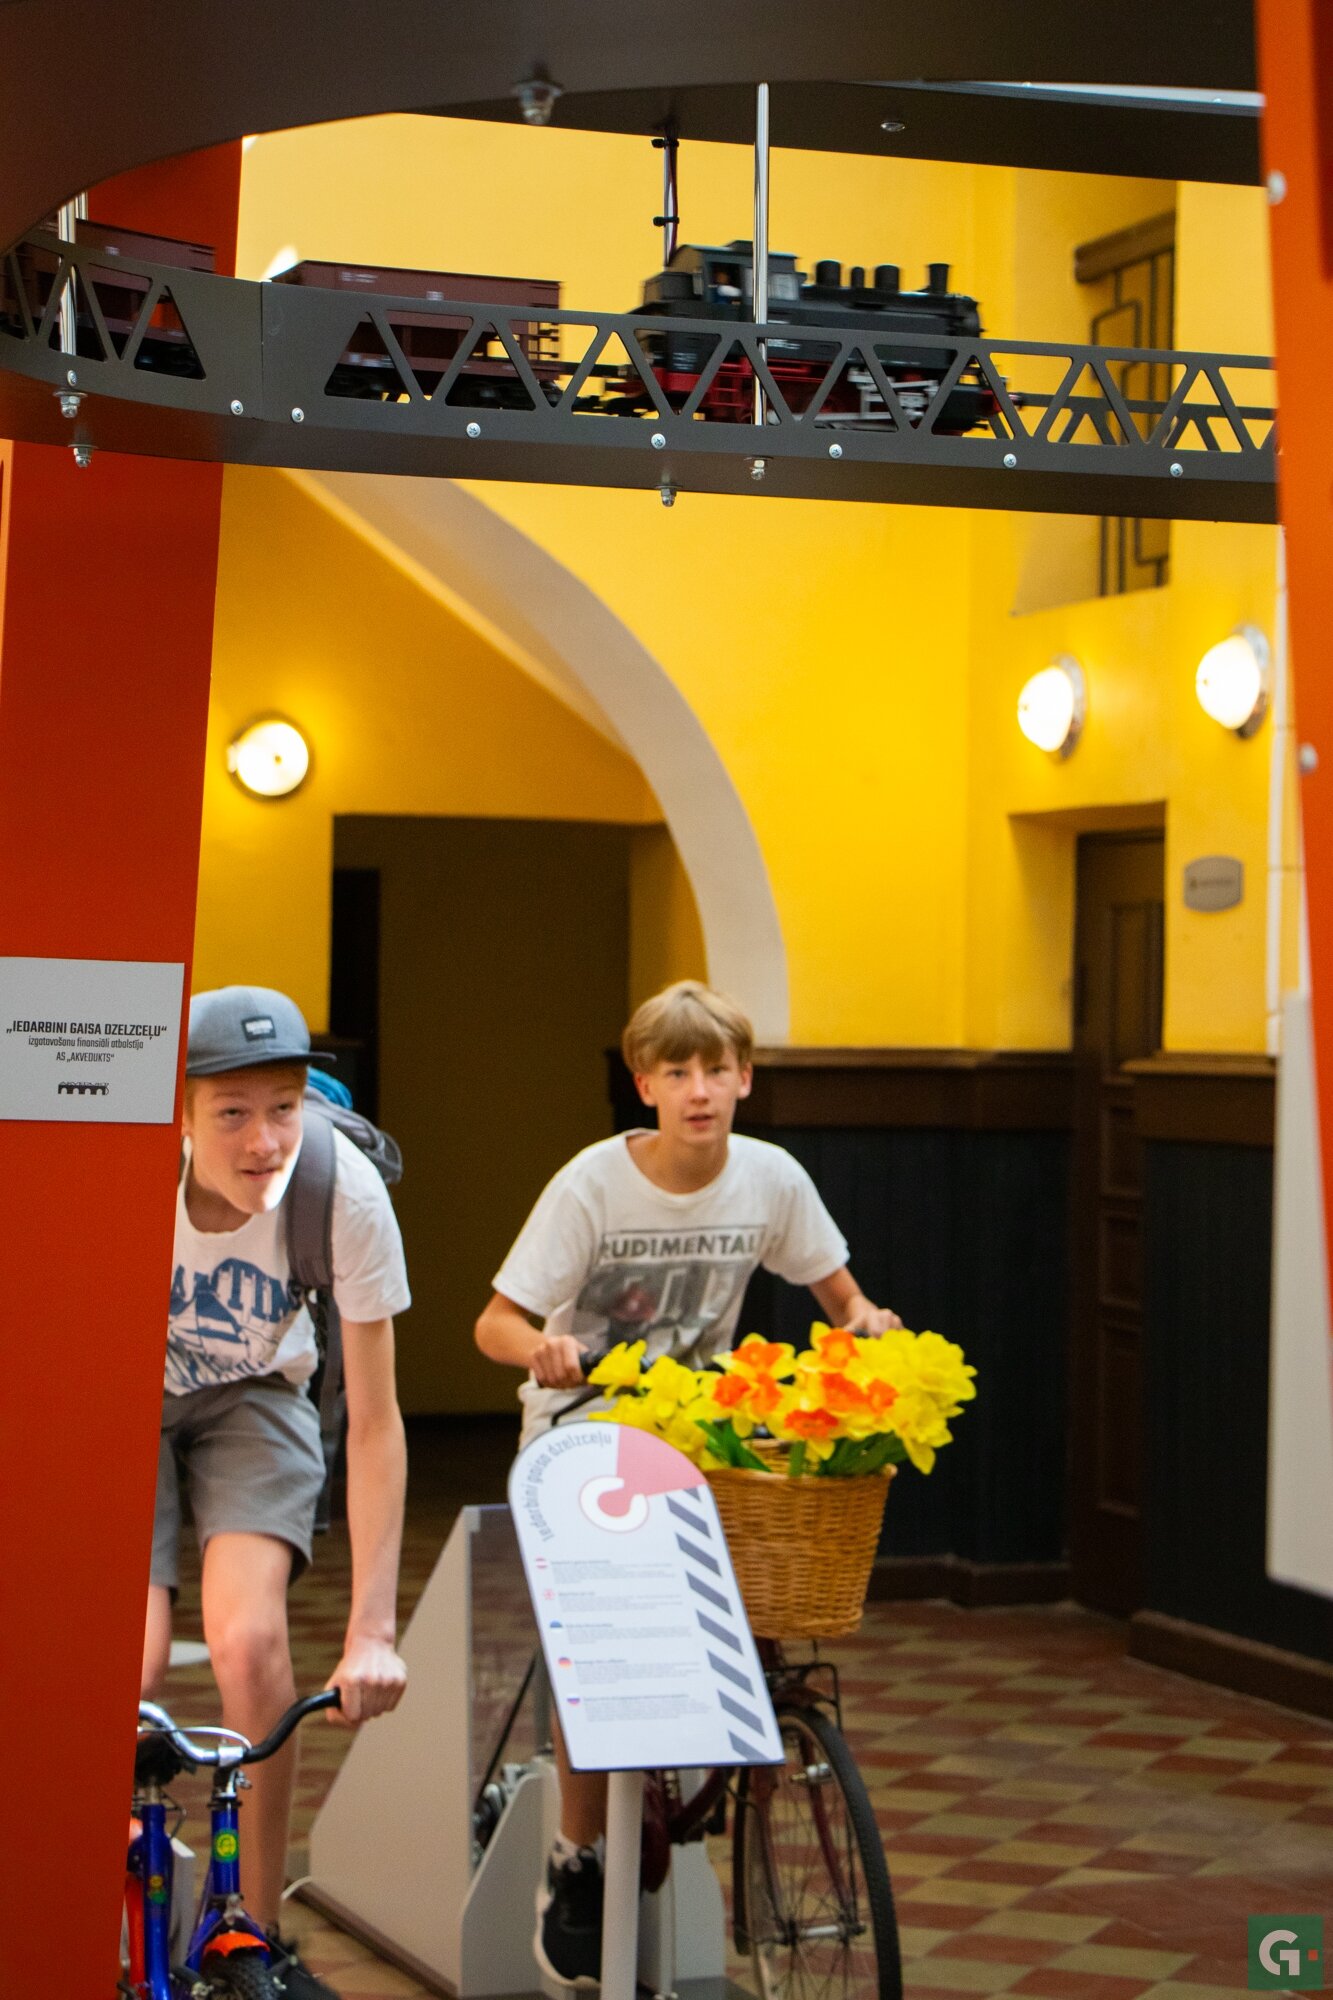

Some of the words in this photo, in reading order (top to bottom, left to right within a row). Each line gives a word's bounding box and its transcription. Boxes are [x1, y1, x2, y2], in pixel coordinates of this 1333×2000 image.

[69, 1022, 102, 1035] GAISA
[28, 1036, 76, 1048] izgatavošanu
[76, 1037, 110, 1048] finansiāli
[110, 1038, 144, 1051] atbalstīja
[56, 1051, 66, 1061] AS
